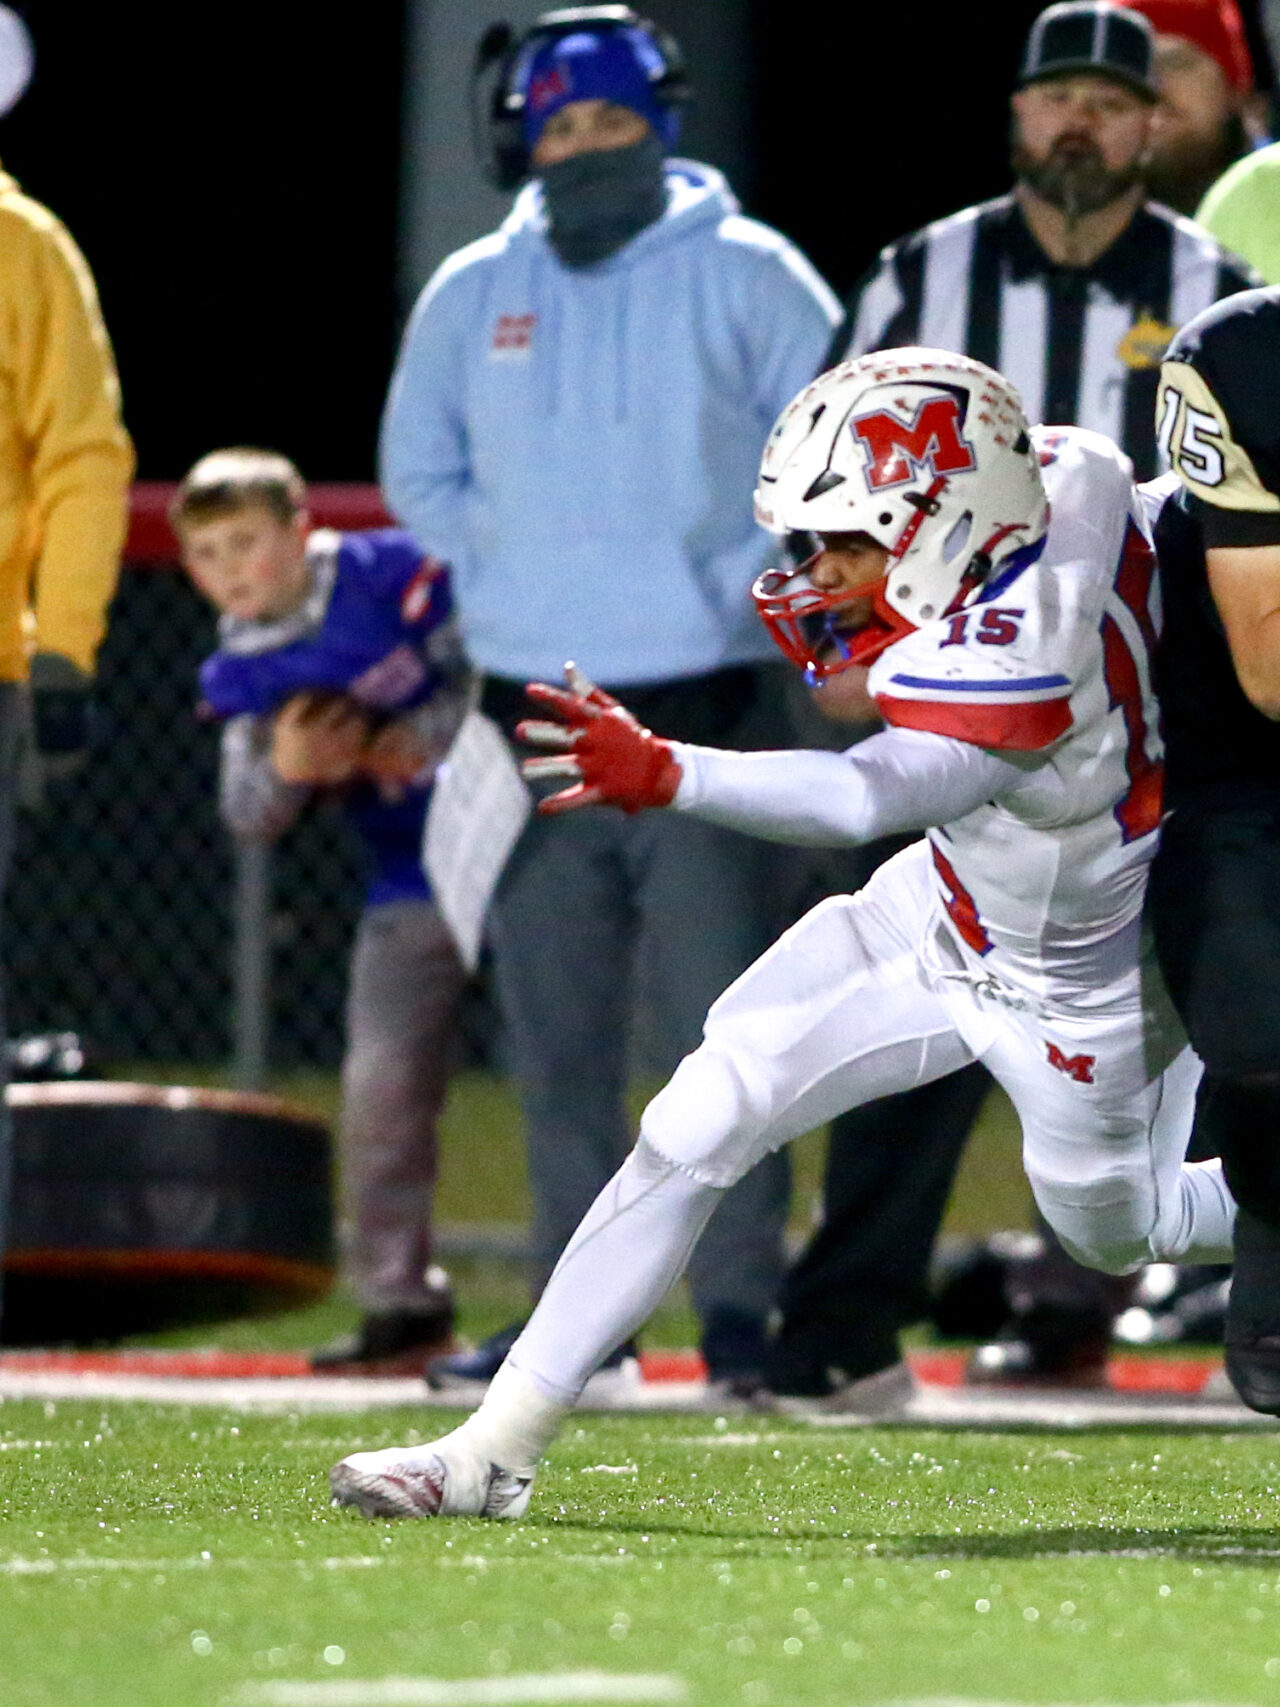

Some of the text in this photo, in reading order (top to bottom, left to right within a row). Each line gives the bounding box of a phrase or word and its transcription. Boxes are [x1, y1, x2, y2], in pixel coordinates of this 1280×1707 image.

[850, 395, 978, 494] M
[1156, 385, 1226, 486] 15
[938, 608, 1025, 650] 15
[1044, 1040, 1096, 1084] M
